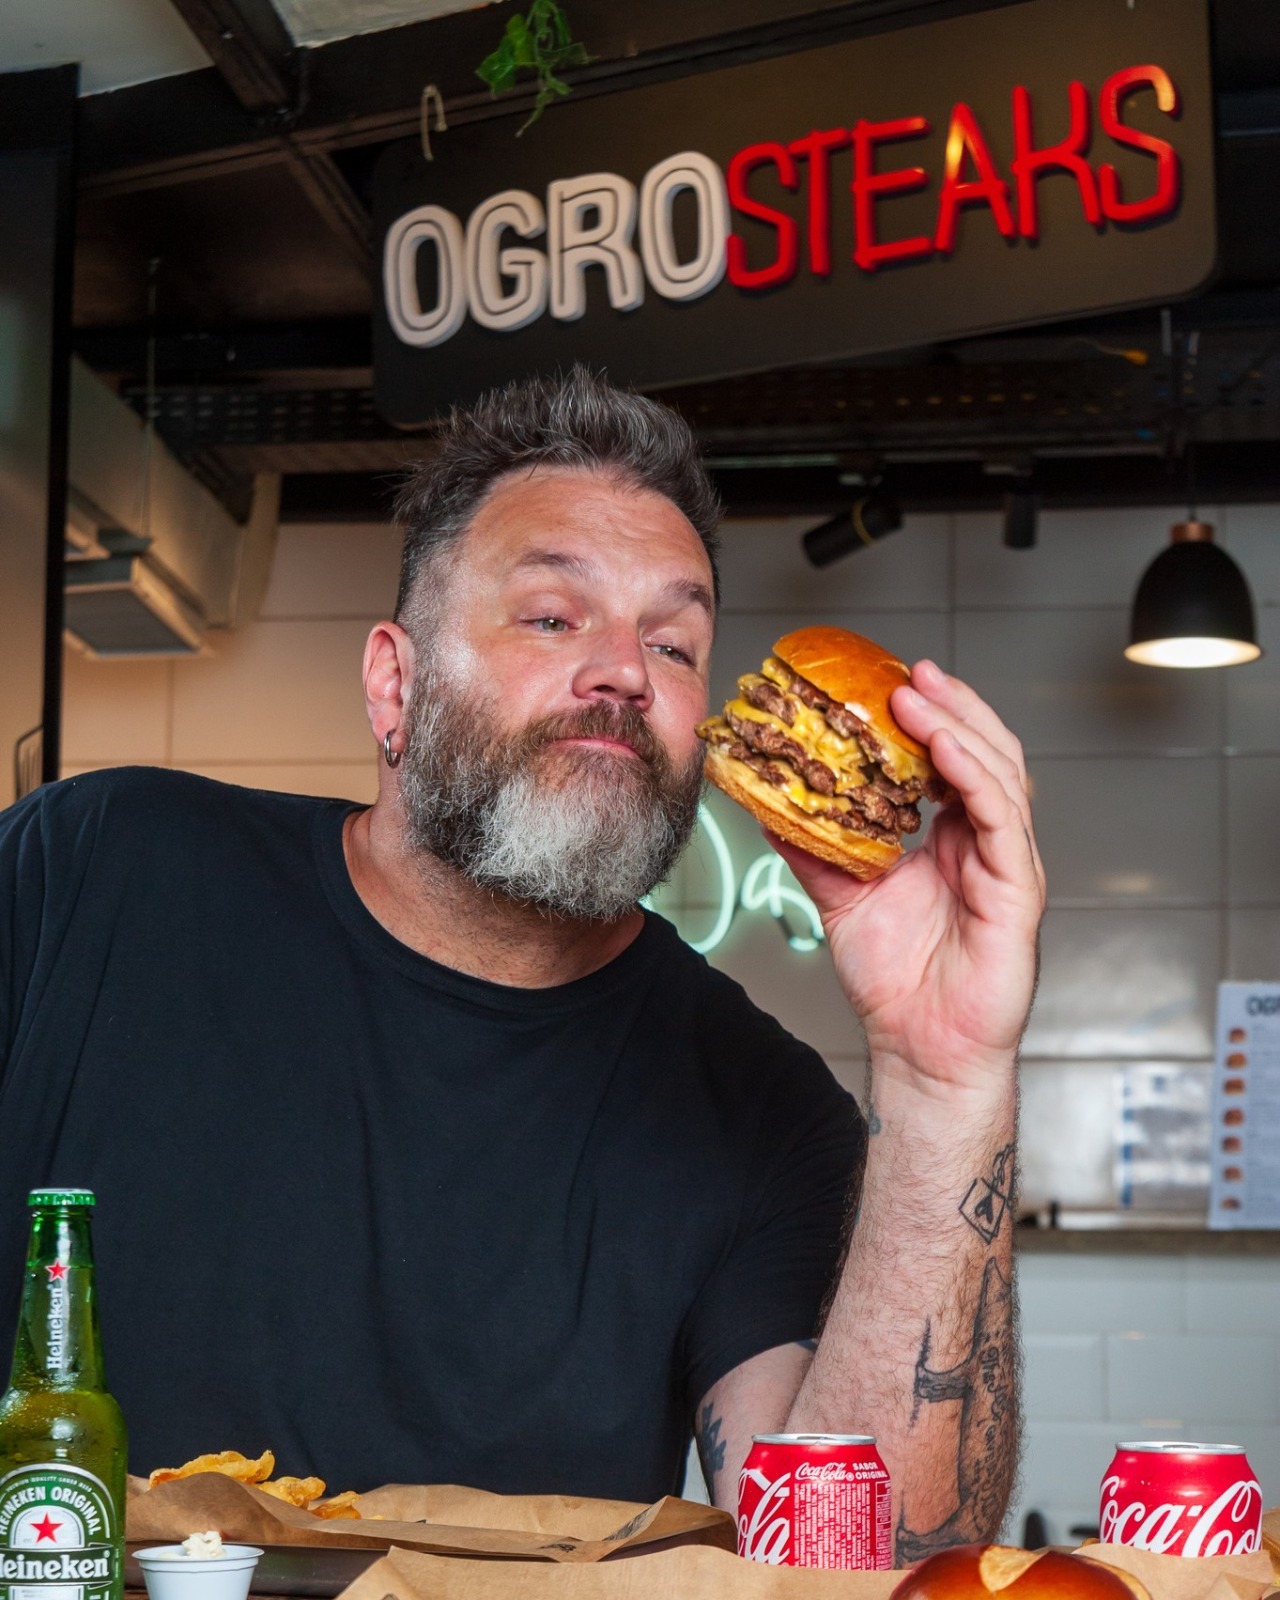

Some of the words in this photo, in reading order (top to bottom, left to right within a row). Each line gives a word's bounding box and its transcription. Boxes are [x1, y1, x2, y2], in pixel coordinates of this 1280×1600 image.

[1245, 994, 1280, 1017] OG
[46, 1286, 63, 1370] Heineken
[794, 1461, 847, 1481] Coca-Cola
[852, 1461, 879, 1471] SABOR
[855, 1470, 888, 1480] ORIGINAL
[0, 1486, 46, 1536] HEINEKEN
[50, 1485, 102, 1536] ORIGINAL
